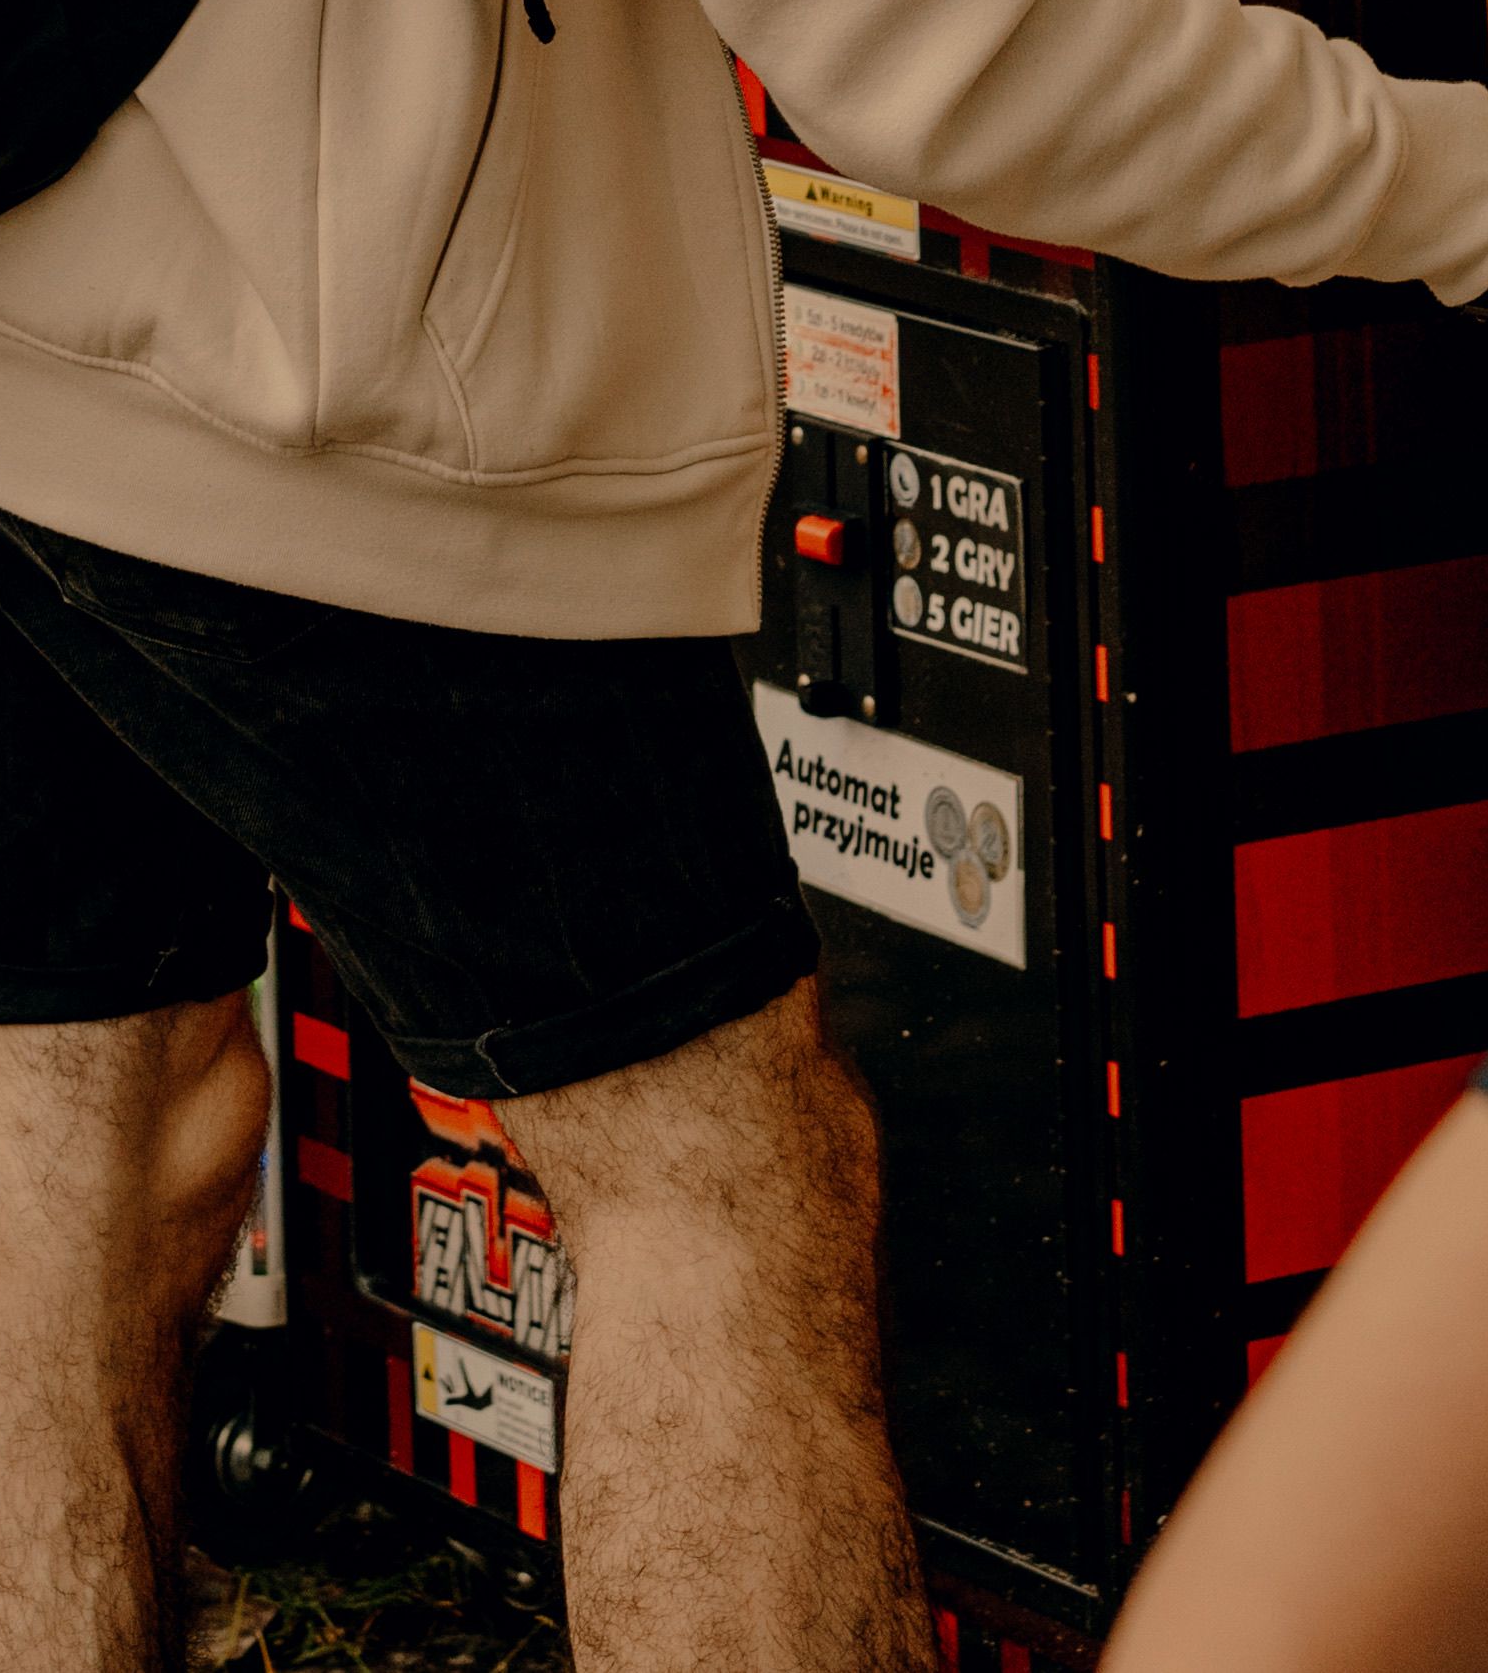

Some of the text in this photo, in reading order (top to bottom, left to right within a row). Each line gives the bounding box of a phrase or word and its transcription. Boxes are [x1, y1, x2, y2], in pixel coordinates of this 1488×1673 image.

[819, 184, 874, 218] Warning
[930, 475, 1009, 534] 1 GRA
[930, 534, 1016, 594] 2 GRY
[925, 591, 1021, 657] 5 GIER
[775, 736, 901, 822] Automat
[793, 798, 936, 883] przyjmuje
[496, 1369, 551, 1407] NOTICE
